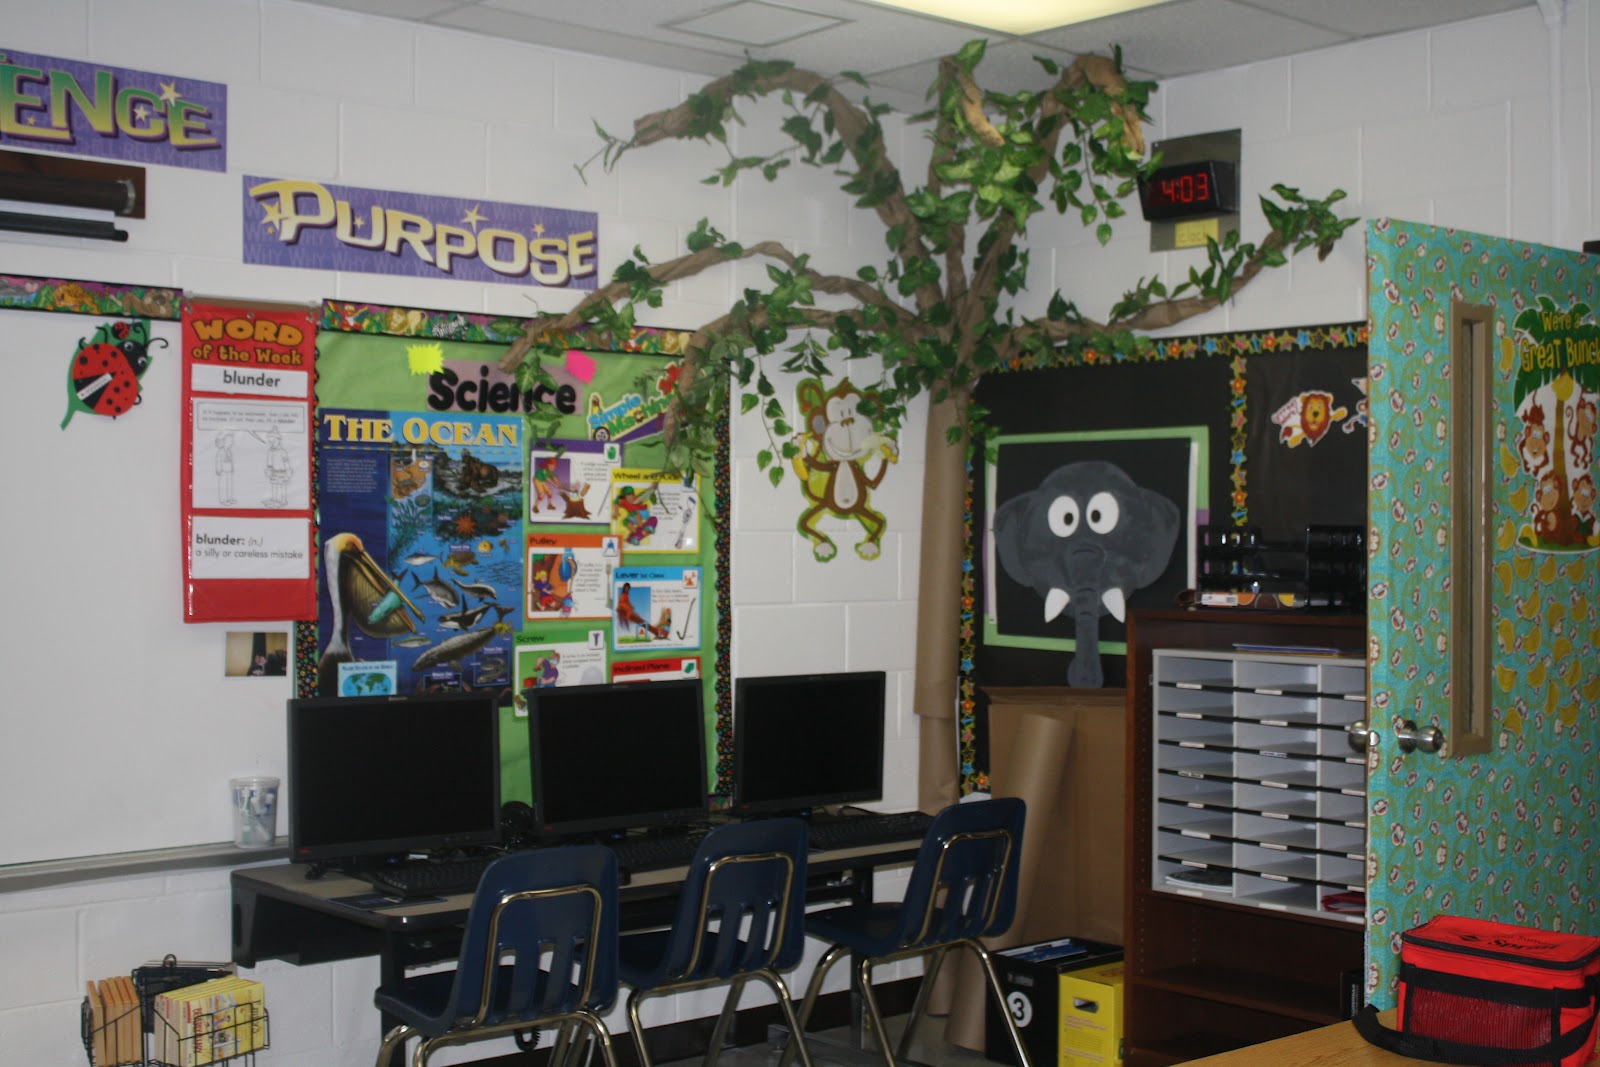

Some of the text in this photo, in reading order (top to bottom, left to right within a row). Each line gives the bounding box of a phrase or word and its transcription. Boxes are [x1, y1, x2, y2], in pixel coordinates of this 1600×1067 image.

[1161, 173, 1209, 203] 4:03
[249, 180, 596, 287] PURPOSE
[191, 319, 303, 347] WORD
[192, 344, 302, 366] of the Week
[223, 370, 280, 387] blunder
[427, 365, 577, 415] Science
[589, 395, 642, 429] Simple
[323, 414, 518, 447] THE OCEAN
[613, 471, 640, 480] Wheel
[196, 533, 263, 547] blunder: (n.)
[529, 537, 557, 546] Pulley
[204, 548, 219, 559] silly
[234, 549, 268, 558] careless
[270, 549, 304, 559] mistake
[516, 635, 545, 643] Screw
[614, 663, 670, 673] Inclined Plane
[1011, 998, 1024, 1021] 3
